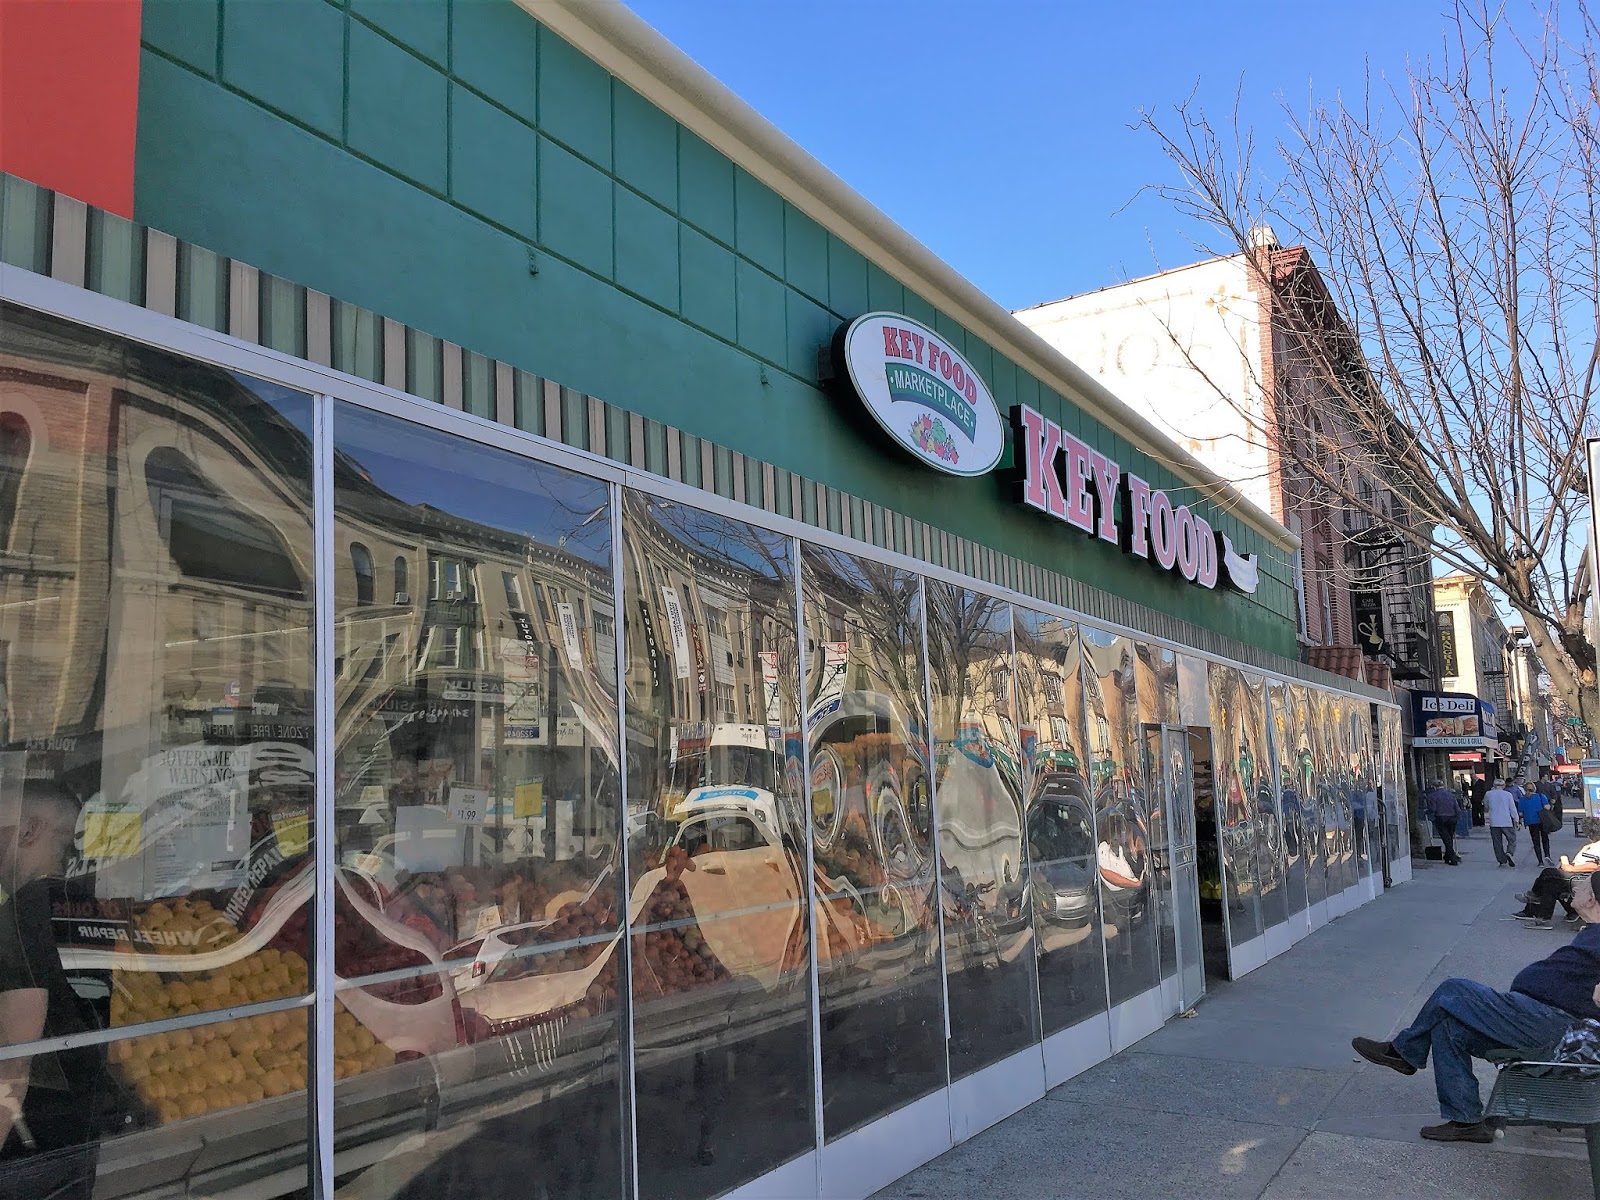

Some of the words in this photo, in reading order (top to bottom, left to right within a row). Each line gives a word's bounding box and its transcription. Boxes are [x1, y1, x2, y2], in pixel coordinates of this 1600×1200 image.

[882, 326, 925, 363] KEY
[928, 346, 978, 406] FOOD
[893, 369, 971, 427] MARKETPLACE
[1020, 403, 1120, 545] KEY
[1128, 472, 1219, 589] FOOD
[1424, 699, 1445, 710] Ice
[1448, 700, 1474, 711] Deli
[457, 809, 477, 820] $1.99
